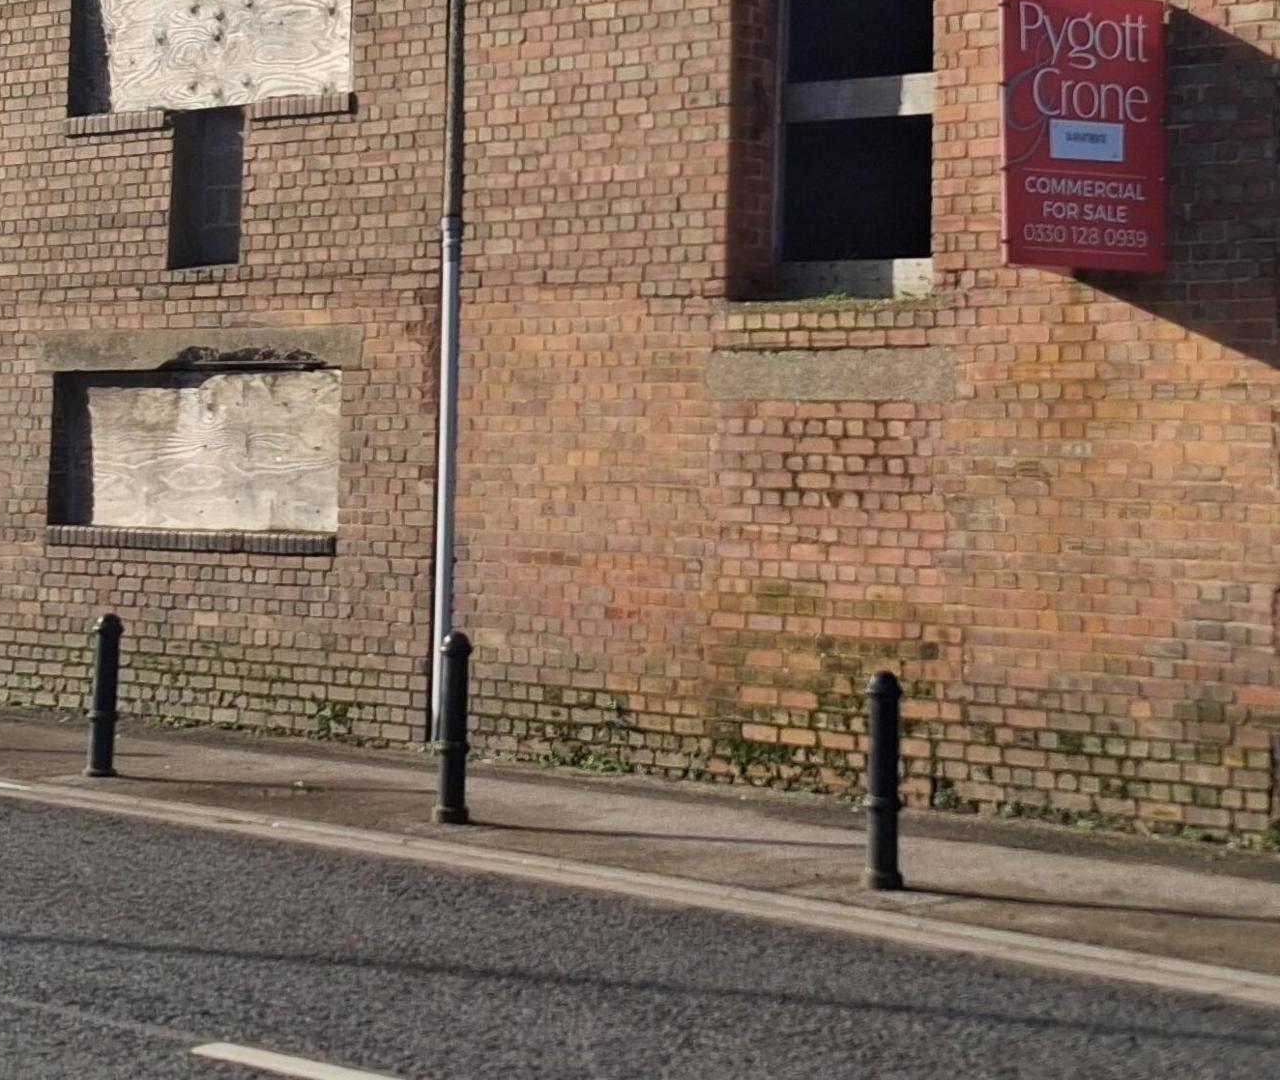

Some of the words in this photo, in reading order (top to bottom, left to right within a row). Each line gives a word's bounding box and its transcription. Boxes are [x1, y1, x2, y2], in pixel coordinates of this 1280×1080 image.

[1019, 0, 1149, 70] Pygott
[1033, 67, 1149, 123] Crone
[1024, 175, 1147, 201] COMMERCIAL
[1042, 200, 1079, 219] FOR
[1083, 202, 1128, 223] SALE
[1023, 223, 1066, 243] 0330
[1071, 226, 1101, 245] 128
[1104, 228, 1149, 248] 0939
